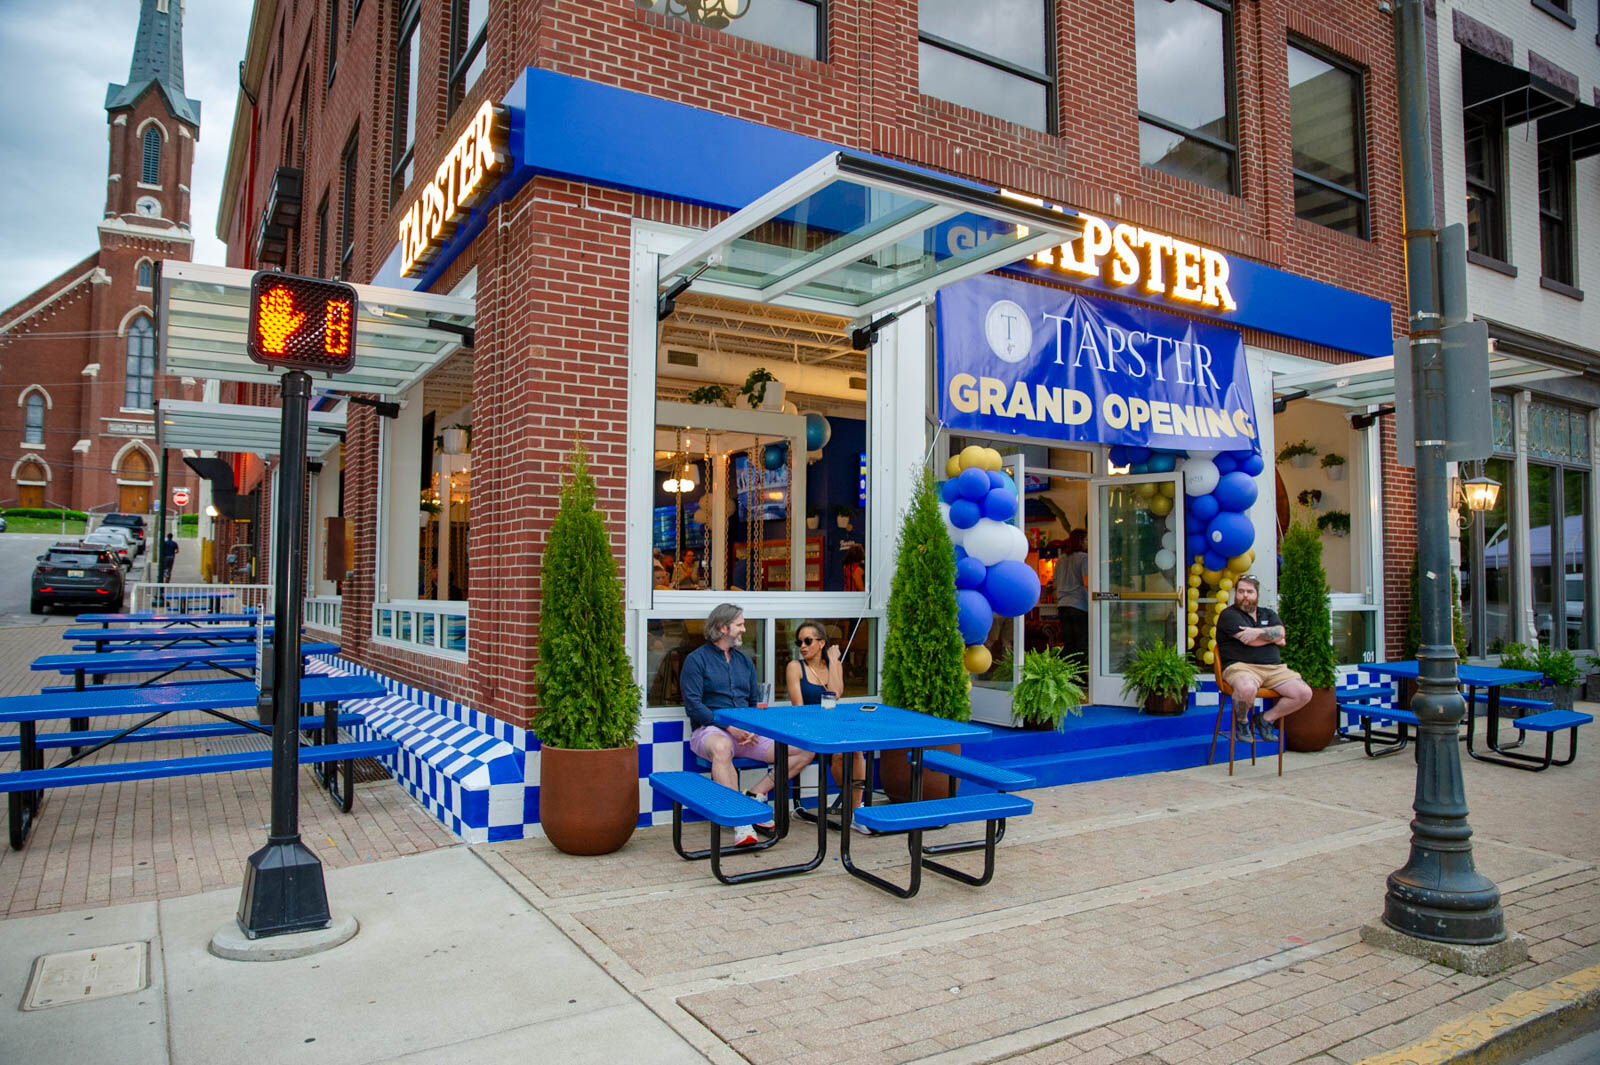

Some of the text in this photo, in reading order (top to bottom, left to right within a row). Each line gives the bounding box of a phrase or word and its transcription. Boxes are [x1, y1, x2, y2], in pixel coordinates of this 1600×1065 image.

[399, 100, 496, 277] TAPSTER
[325, 299, 351, 354] 8
[1042, 312, 1221, 390] TAPSTER
[949, 373, 1257, 439] GRAND OPENING
[1362, 651, 1374, 663] 101
